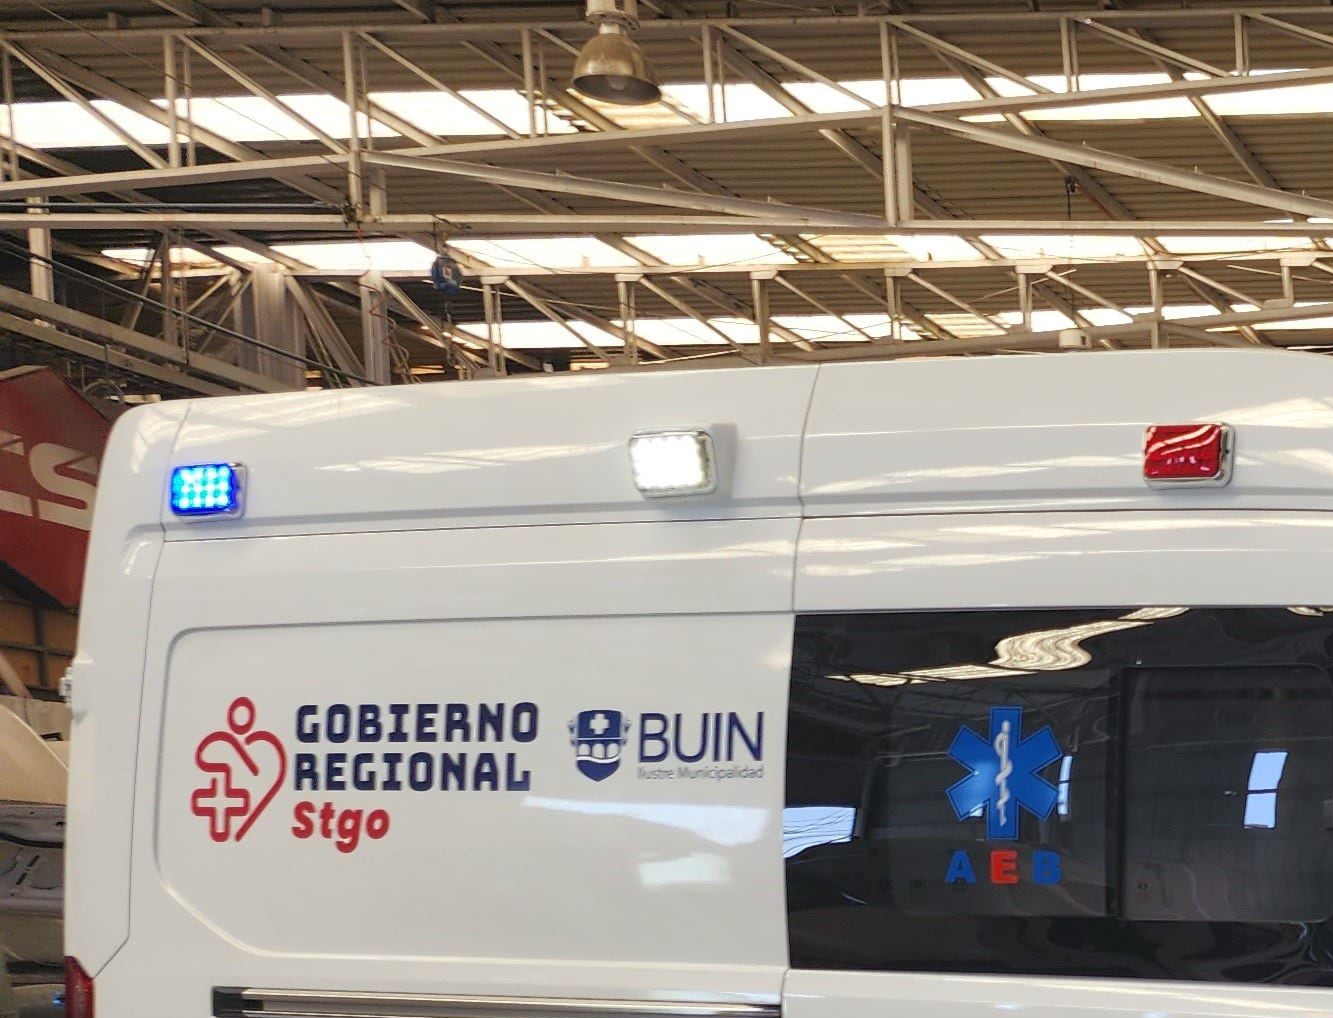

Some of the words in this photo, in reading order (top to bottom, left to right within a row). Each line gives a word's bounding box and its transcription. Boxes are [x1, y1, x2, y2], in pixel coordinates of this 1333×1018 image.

[296, 702, 539, 743] GOBIERNO
[639, 711, 764, 763] BUIN
[294, 752, 530, 792] REGIONAL
[678, 765, 764, 781] Municipalidad
[291, 801, 390, 853] Stgo
